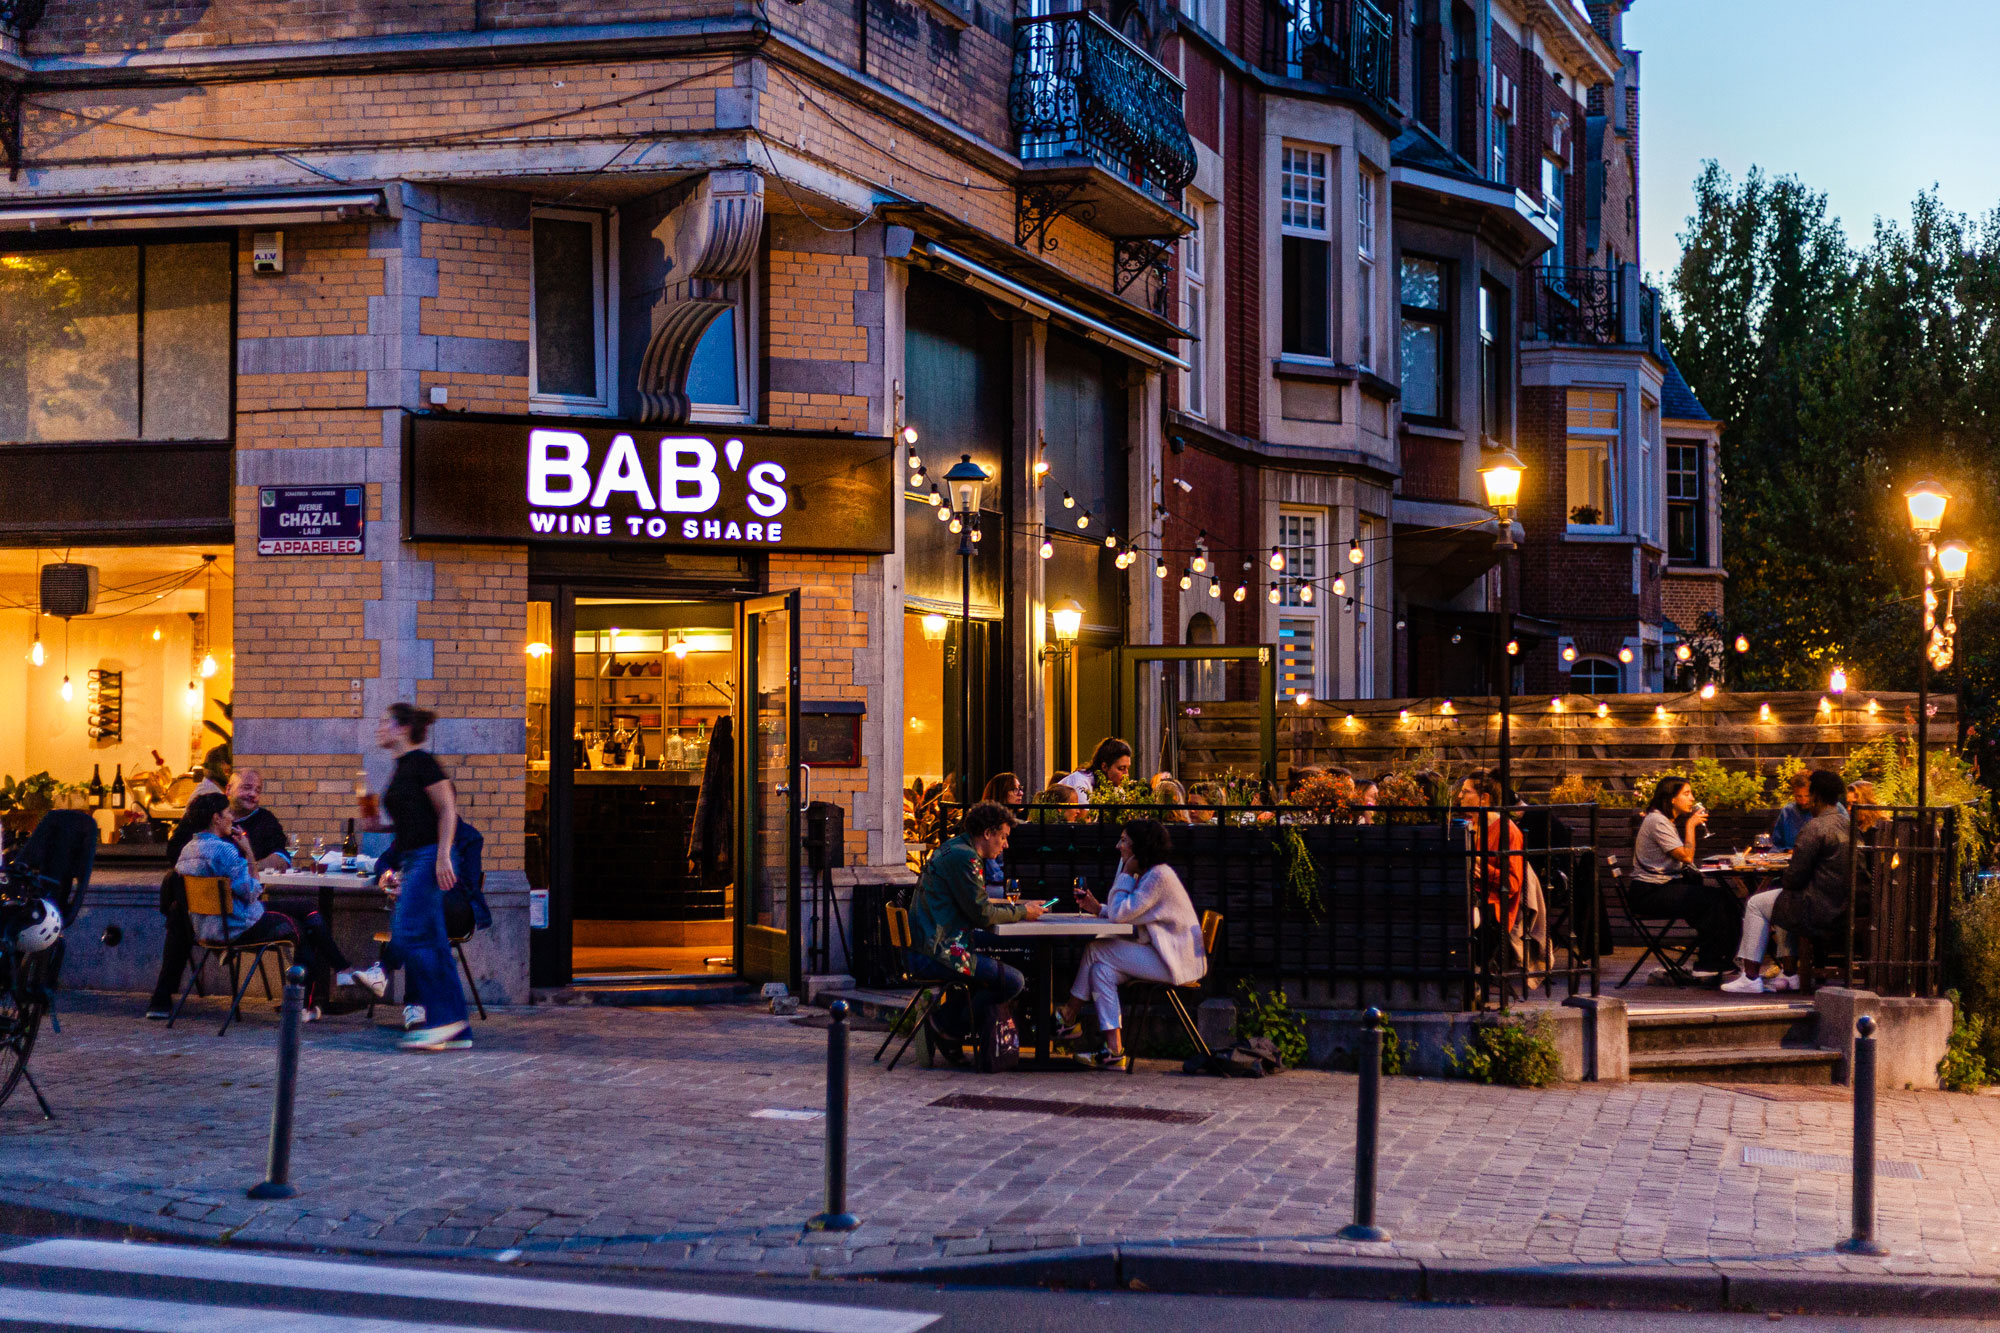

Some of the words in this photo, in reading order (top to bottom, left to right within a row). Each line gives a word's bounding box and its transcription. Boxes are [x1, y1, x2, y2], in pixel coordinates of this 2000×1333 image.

[527, 428, 788, 518] BAB's
[298, 504, 322, 512] AVENUE
[280, 512, 341, 527] CHAZAL
[529, 511, 612, 535] WINE
[626, 515, 667, 538] TO
[682, 518, 783, 542] SHARE
[273, 541, 356, 553] APPARELEC
